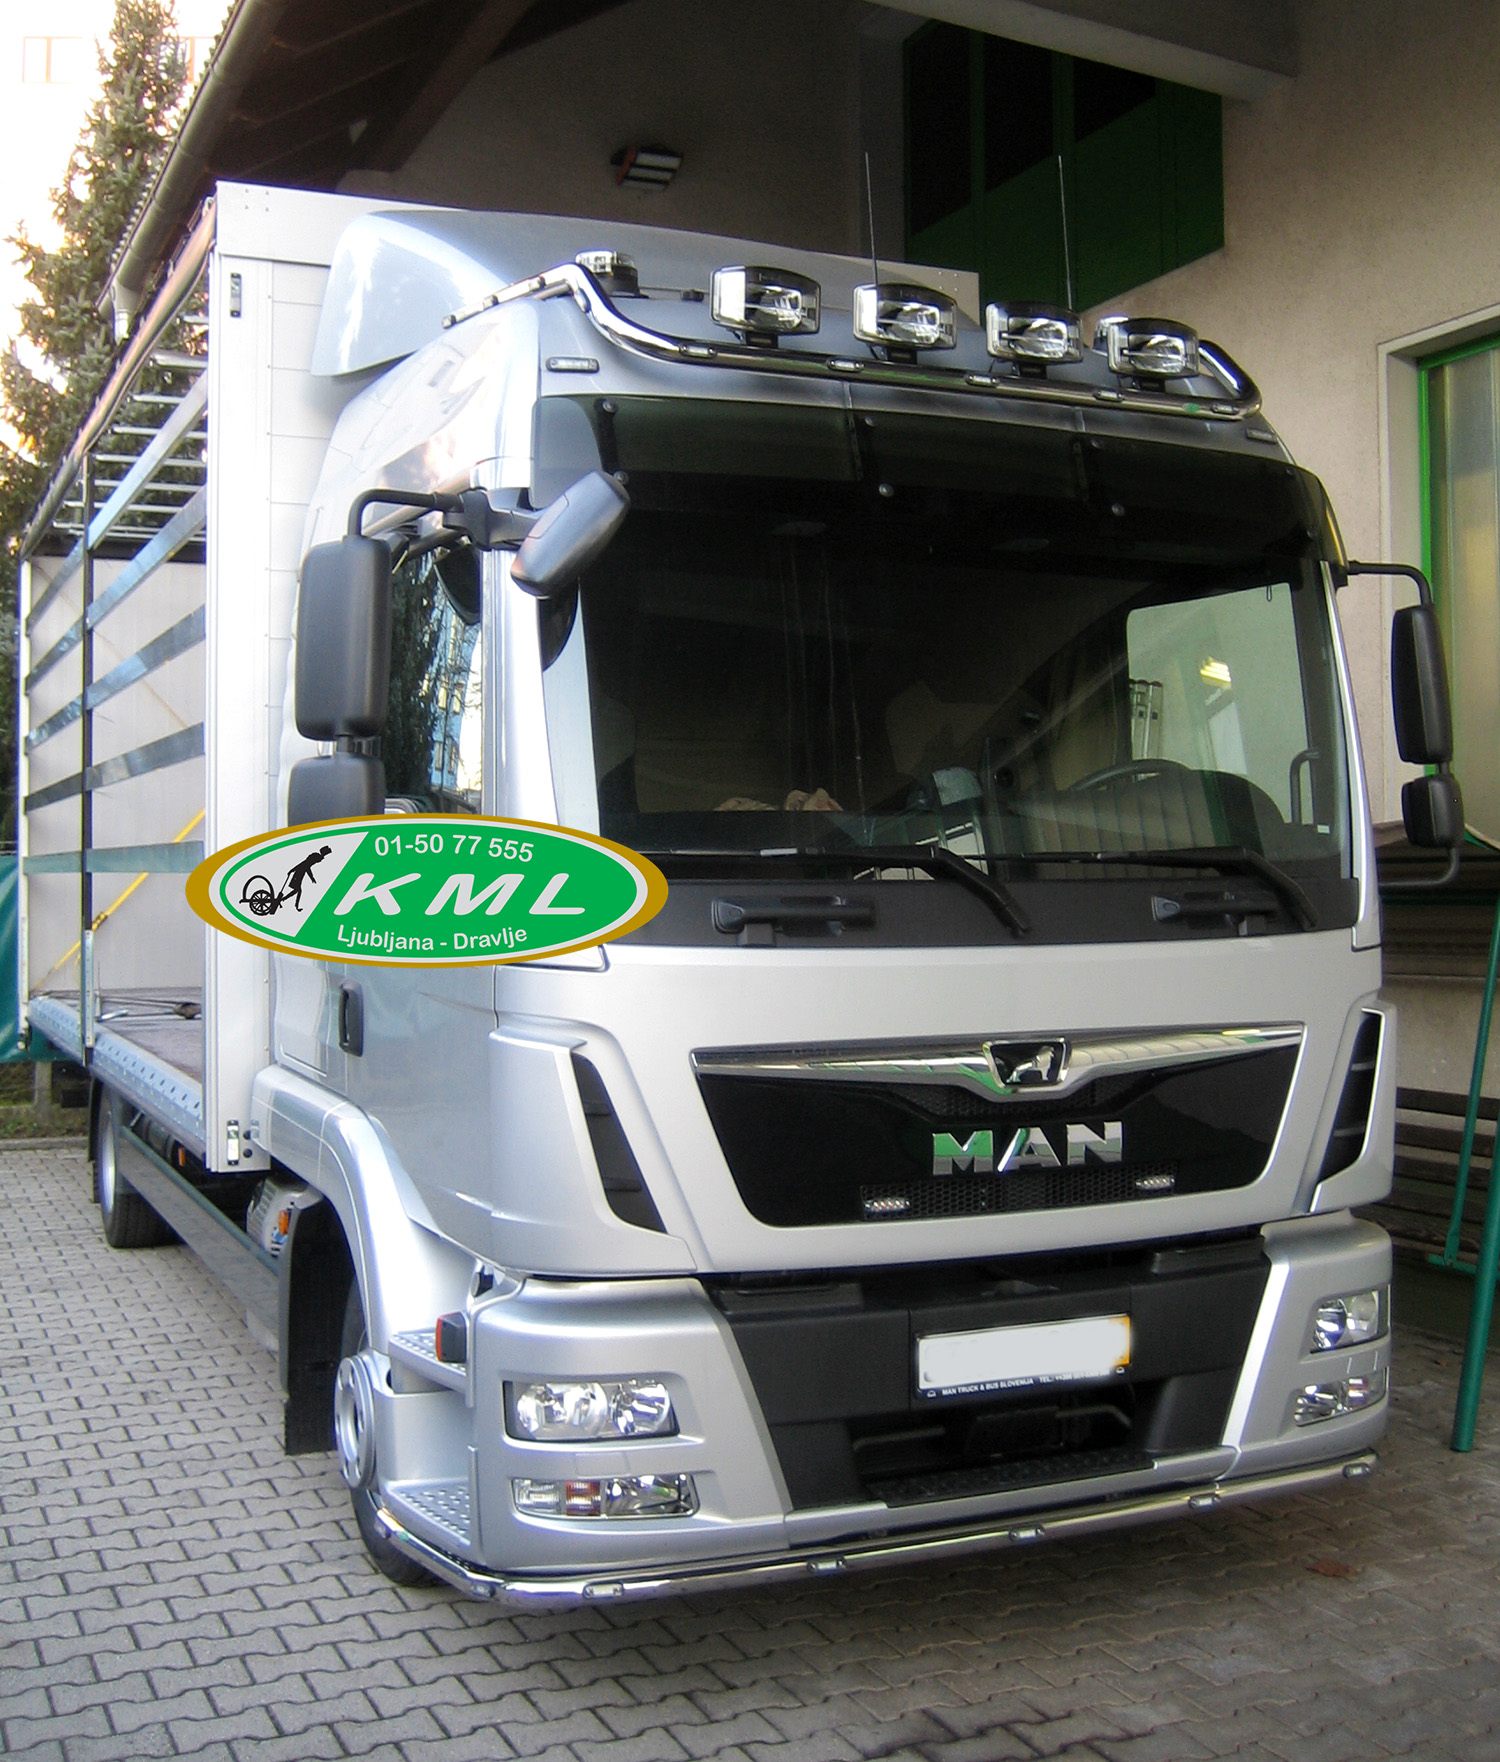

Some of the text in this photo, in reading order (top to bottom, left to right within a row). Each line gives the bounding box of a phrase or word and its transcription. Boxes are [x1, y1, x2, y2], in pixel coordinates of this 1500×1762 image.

[932, 1121, 1124, 1175] MAN
[941, 1387, 957, 1396] MAN
[958, 1384, 979, 1394] TRUCK
[985, 1382, 999, 1391] BUS
[1000, 1378, 1034, 1389] SLOVENIJA
